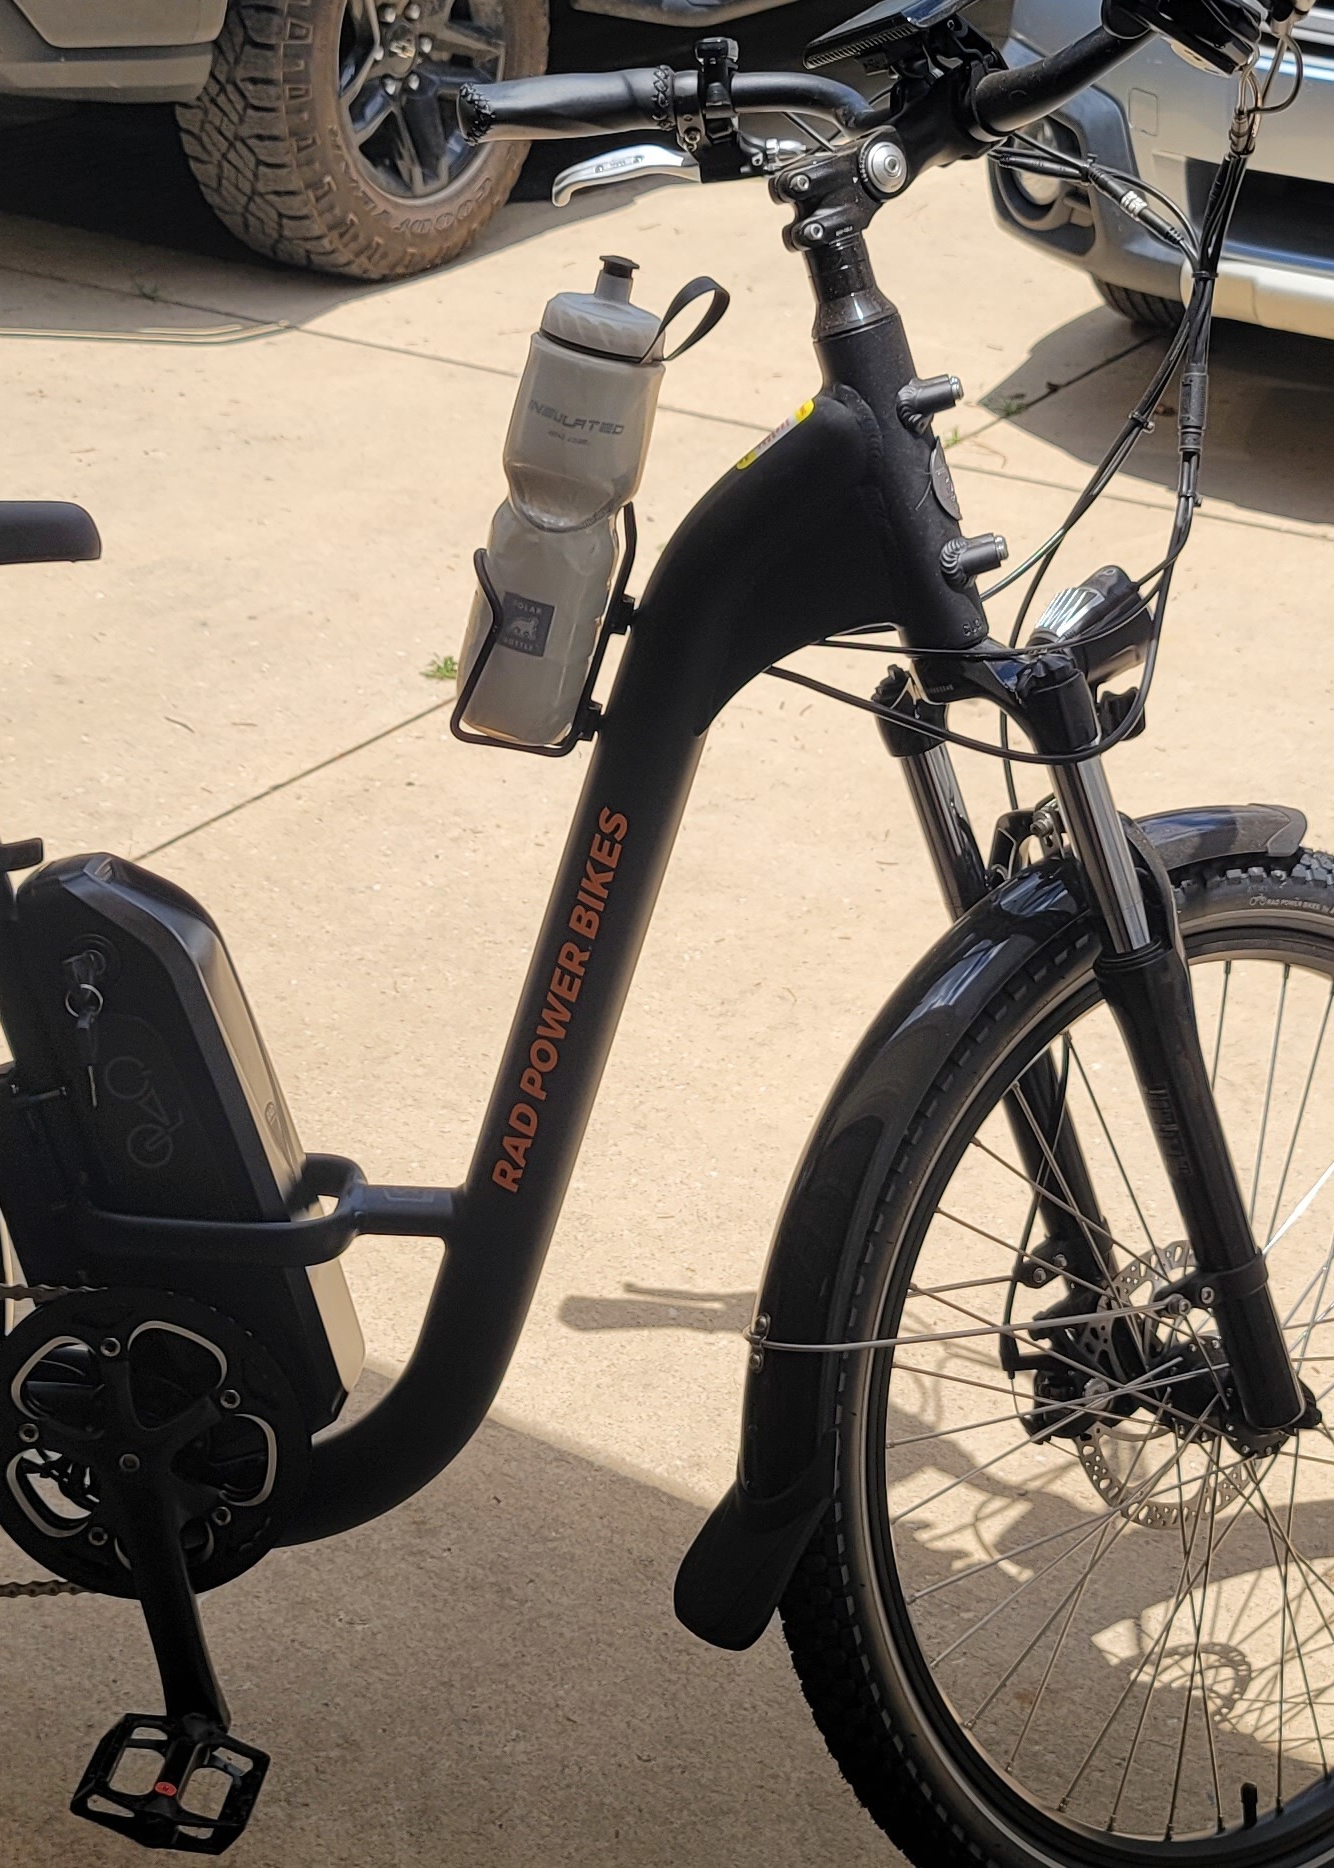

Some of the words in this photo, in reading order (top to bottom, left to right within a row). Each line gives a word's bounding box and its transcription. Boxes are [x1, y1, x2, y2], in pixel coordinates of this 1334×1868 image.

[528, 399, 625, 435] INSULATED
[491, 1102, 540, 1194] RAD
[519, 940, 591, 1100] POWER
[568, 806, 629, 940] BIKES
